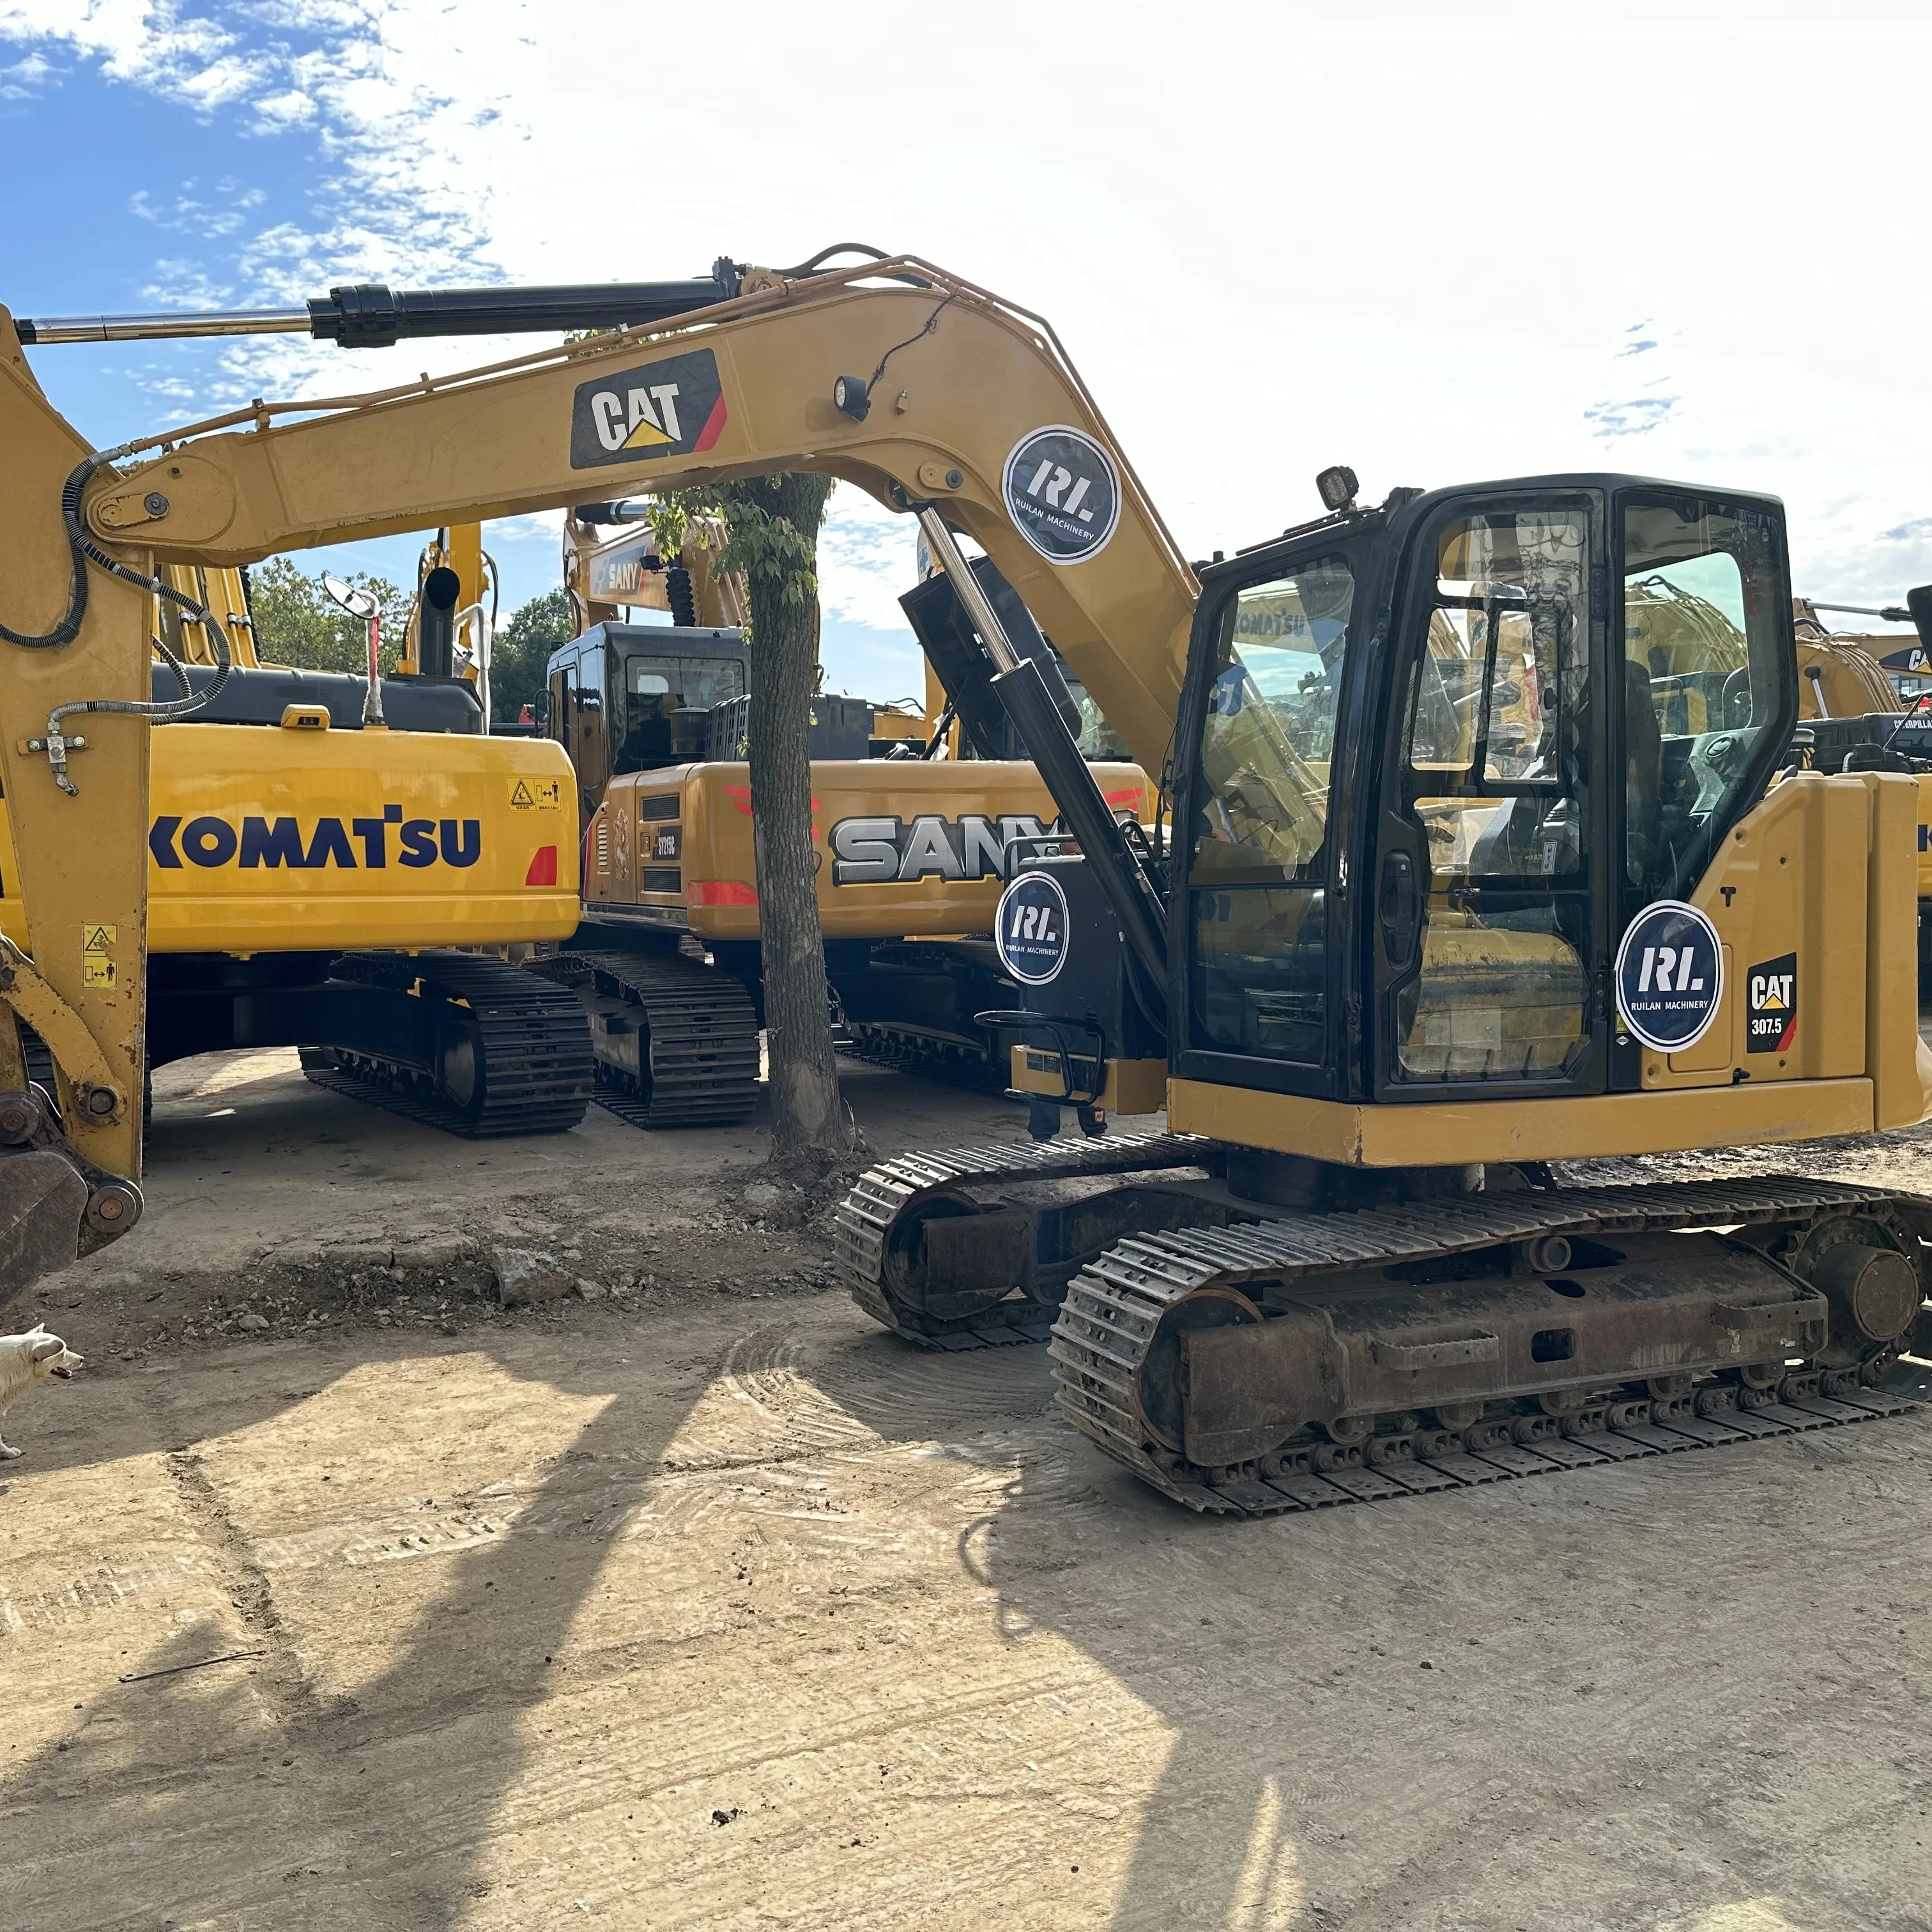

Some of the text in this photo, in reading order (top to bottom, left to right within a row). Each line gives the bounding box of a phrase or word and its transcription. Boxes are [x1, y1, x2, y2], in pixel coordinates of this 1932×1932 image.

[592, 383, 682, 450] CAT
[1016, 498, 1094, 540] RUILAN MACHINERY
[609, 563, 638, 589] SANY
[1908, 649, 1930, 671] CA
[1894, 719, 1932, 729] CAERPILLA
[149, 804, 480, 868] KOMATSU
[1006, 944, 1059, 956] RUILAN MACHINERY
[1751, 975, 1793, 1009] CAT
[1631, 1000, 1708, 1011] RUILAN MACHINERY
[1751, 1018, 1782, 1035] 307.5
